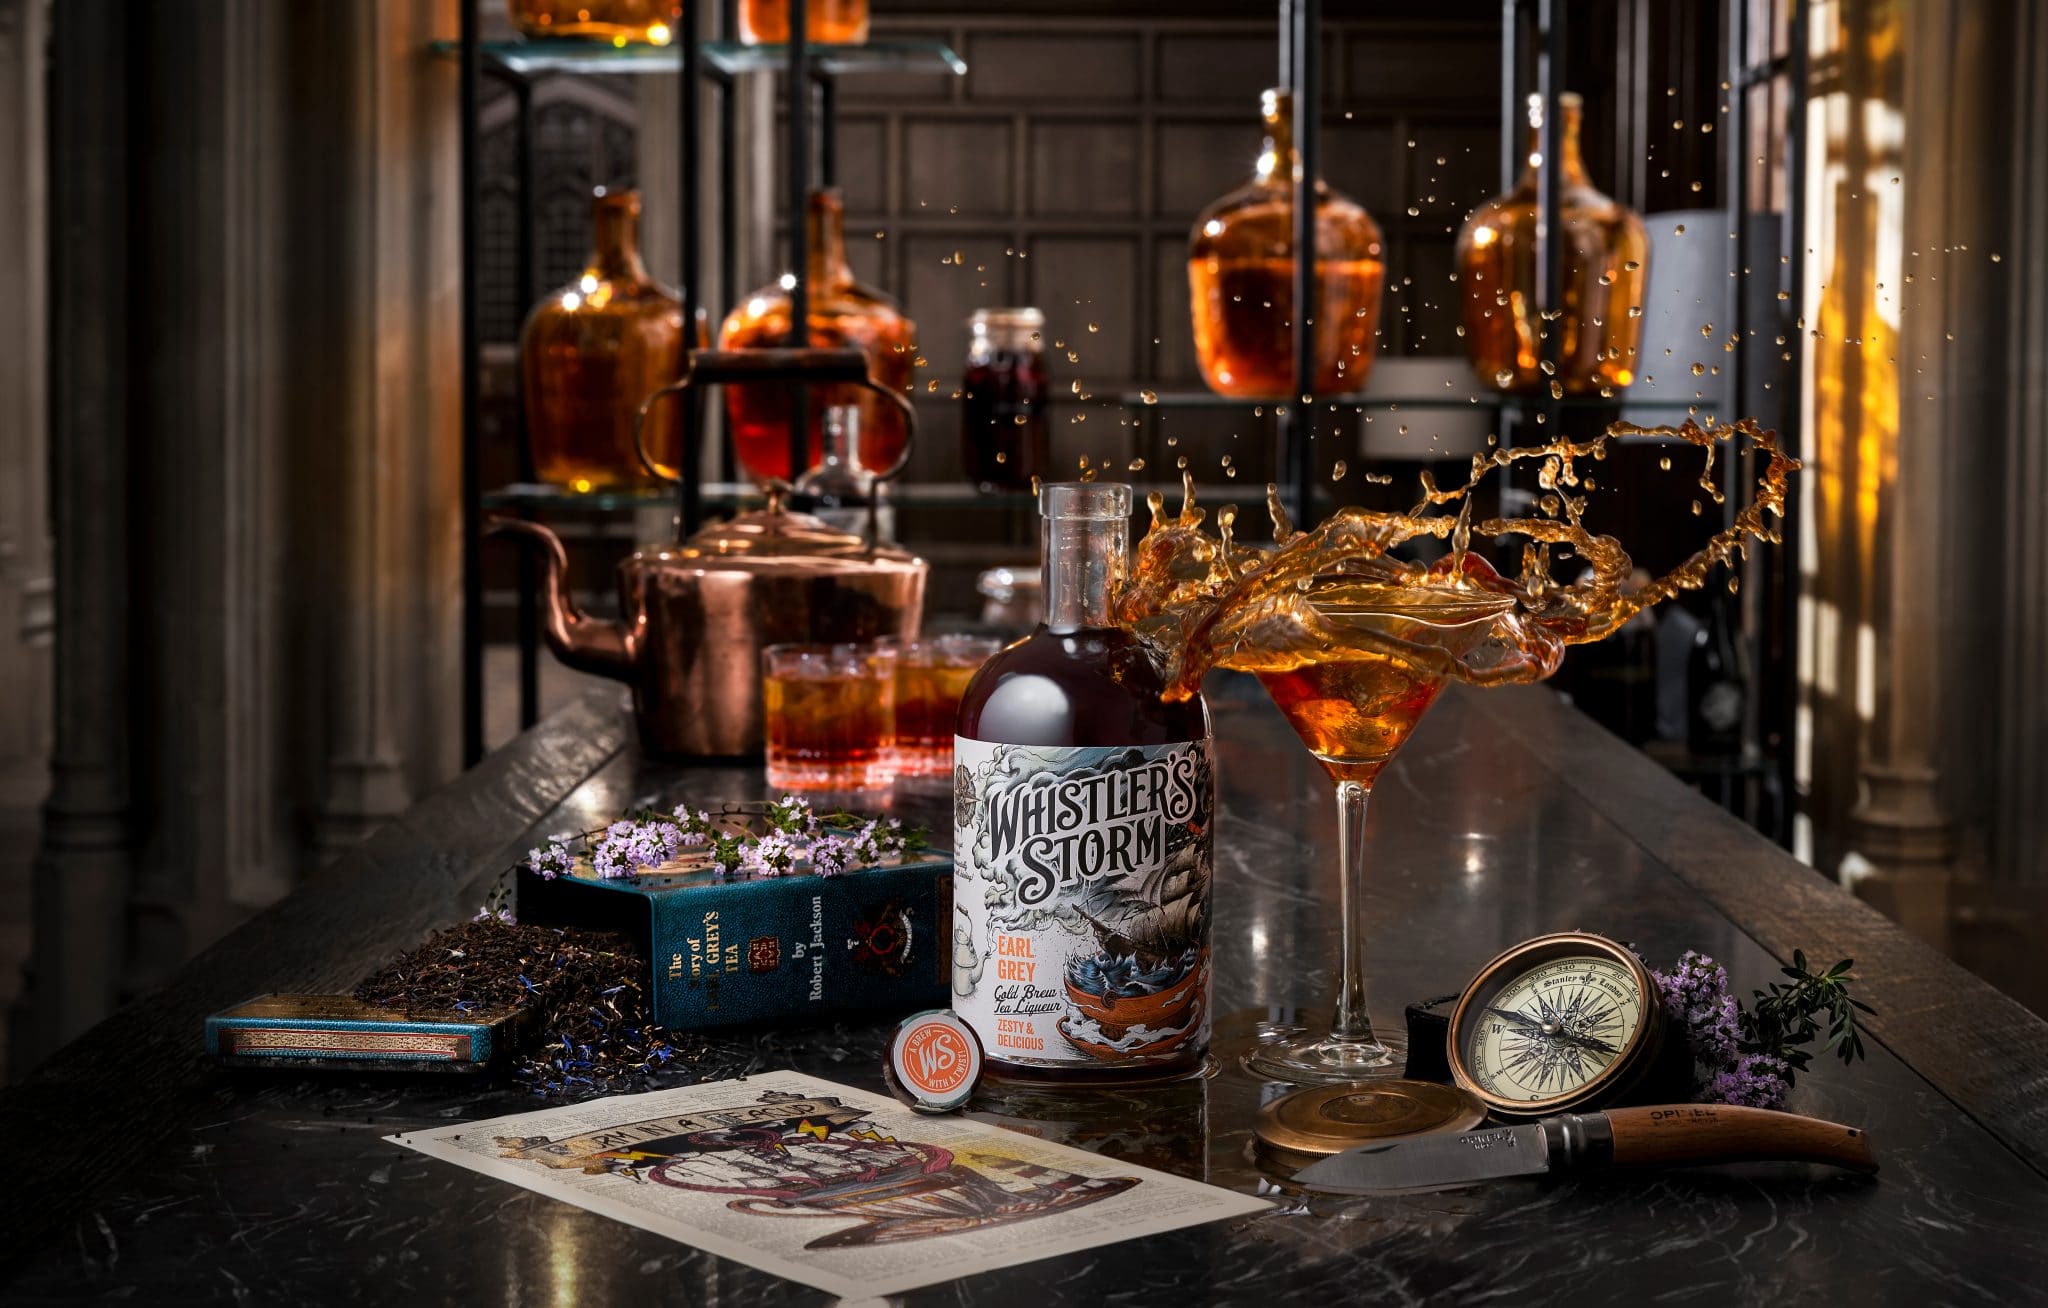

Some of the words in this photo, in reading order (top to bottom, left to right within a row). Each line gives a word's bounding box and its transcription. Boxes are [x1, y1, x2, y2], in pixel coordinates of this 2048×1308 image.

[990, 751, 1195, 862] WHISTLER'S
[1018, 815, 1161, 904] STORM
[810, 896, 825, 948] Jackson
[687, 938, 700, 951] of
[703, 911, 719, 964] GREY'S
[998, 935, 1035, 958] EARL
[726, 944, 738, 975] TEA
[792, 942, 806, 958] by
[669, 953, 682, 980] The
[809, 955, 822, 1000] Robert
[998, 959, 1036, 982] GREY
[1612, 971, 1624, 980] 20
[994, 985, 1019, 1000] Cold
[1022, 984, 1057, 1000] Brew
[1543, 975, 1578, 988] Stanley
[1599, 977, 1623, 998] London
[994, 999, 1011, 1013] Tea
[1013, 999, 1061, 1017] Liqueur
[913, 1028, 932, 1047] BREW
[998, 1019, 1025, 1034] ZESTY
[1026, 1022, 1034, 1035] &
[1492, 1023, 1506, 1034] W
[998, 1034, 1044, 1050] DELICIOUS
[918, 1033, 956, 1081] WS
[928, 1078, 949, 1088] WITH
[949, 1076, 956, 1085] A
